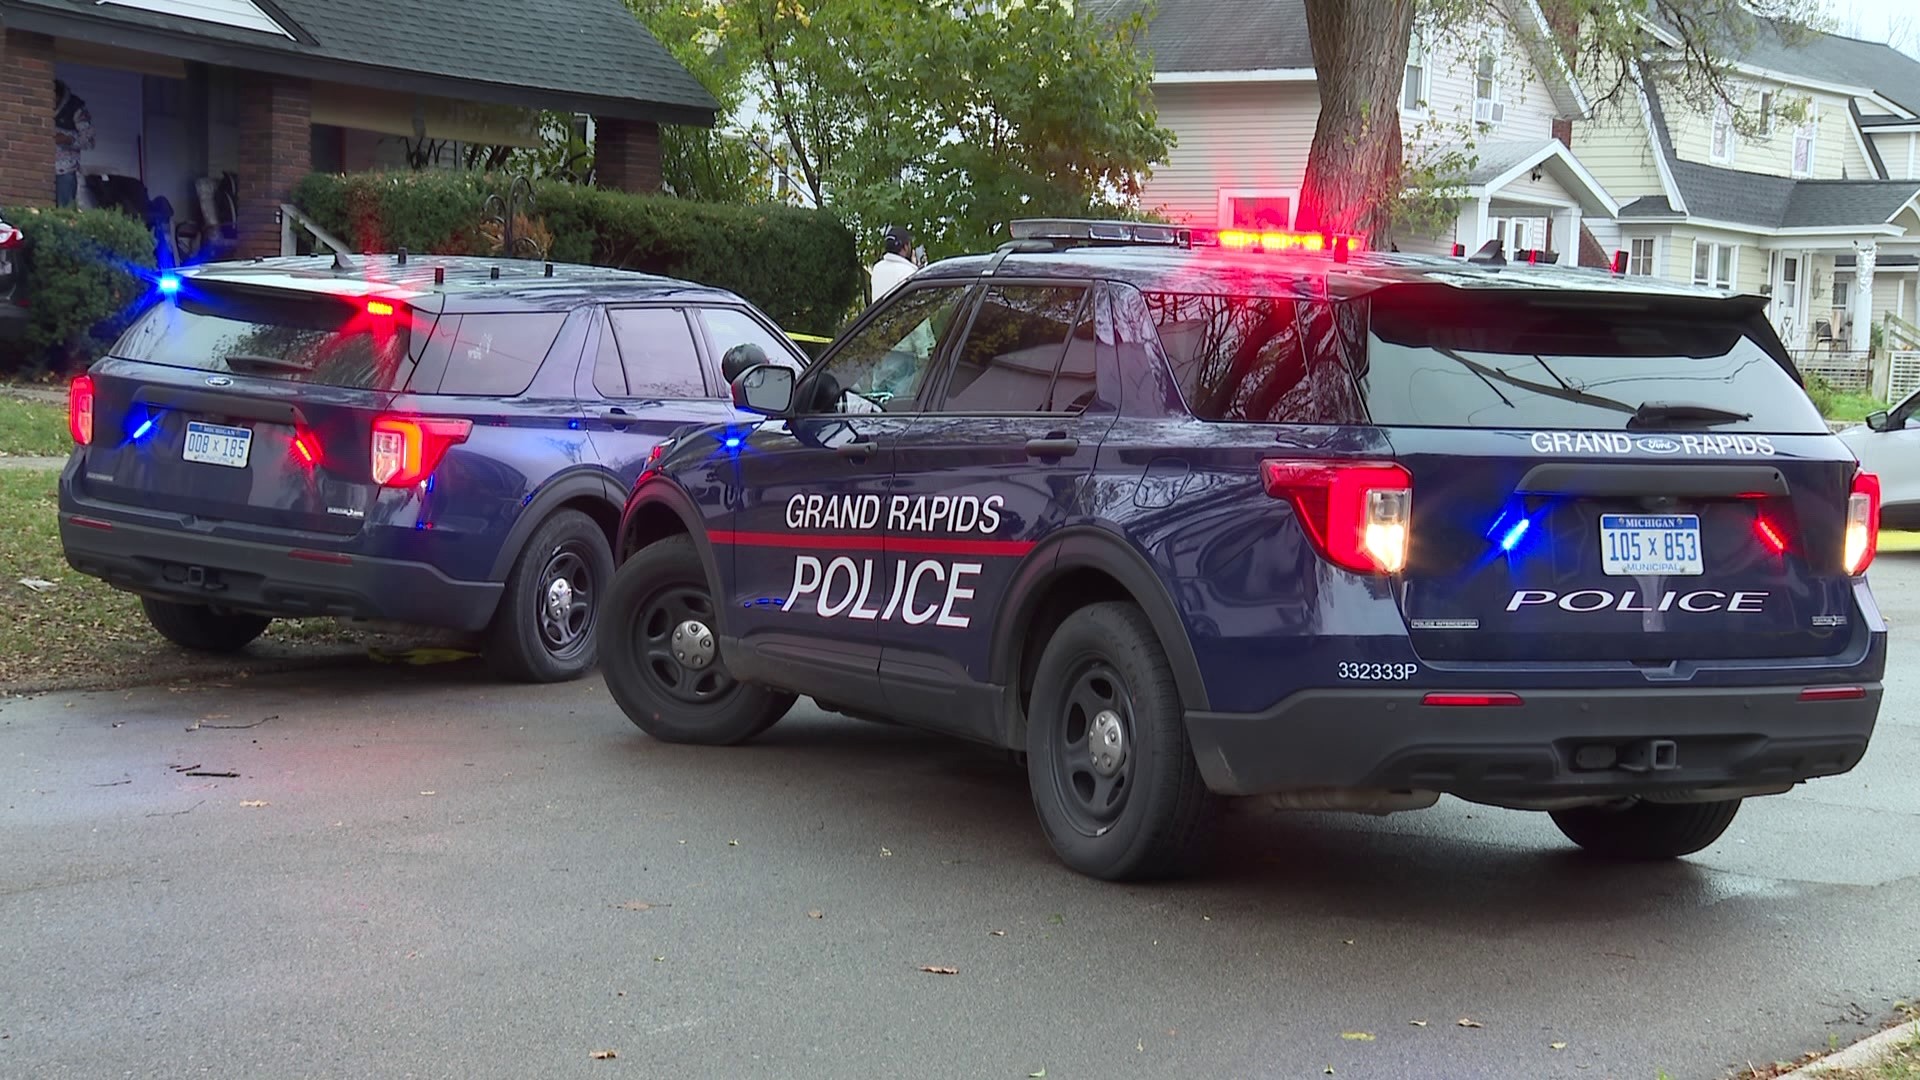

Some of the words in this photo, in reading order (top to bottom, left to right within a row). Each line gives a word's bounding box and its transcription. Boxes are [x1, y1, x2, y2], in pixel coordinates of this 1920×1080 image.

[203, 426, 235, 436] MICHIGAN
[188, 433, 209, 454] 008
[222, 438, 245, 458] 185
[1531, 432, 1632, 454] GRAND
[1680, 435, 1775, 456] RAPIDS
[785, 494, 880, 530] GRAND
[887, 495, 1004, 533] RAPIDS
[1625, 519, 1675, 528] MICHIGAN
[1608, 532, 1641, 561] 105
[1648, 537, 1657, 556] X
[1664, 532, 1697, 561] 853
[1626, 563, 1681, 572] MUNICIPAL
[781, 555, 982, 628] POLICE
[1505, 590, 1769, 612] POLICE
[1338, 661, 1418, 680] 332333P
